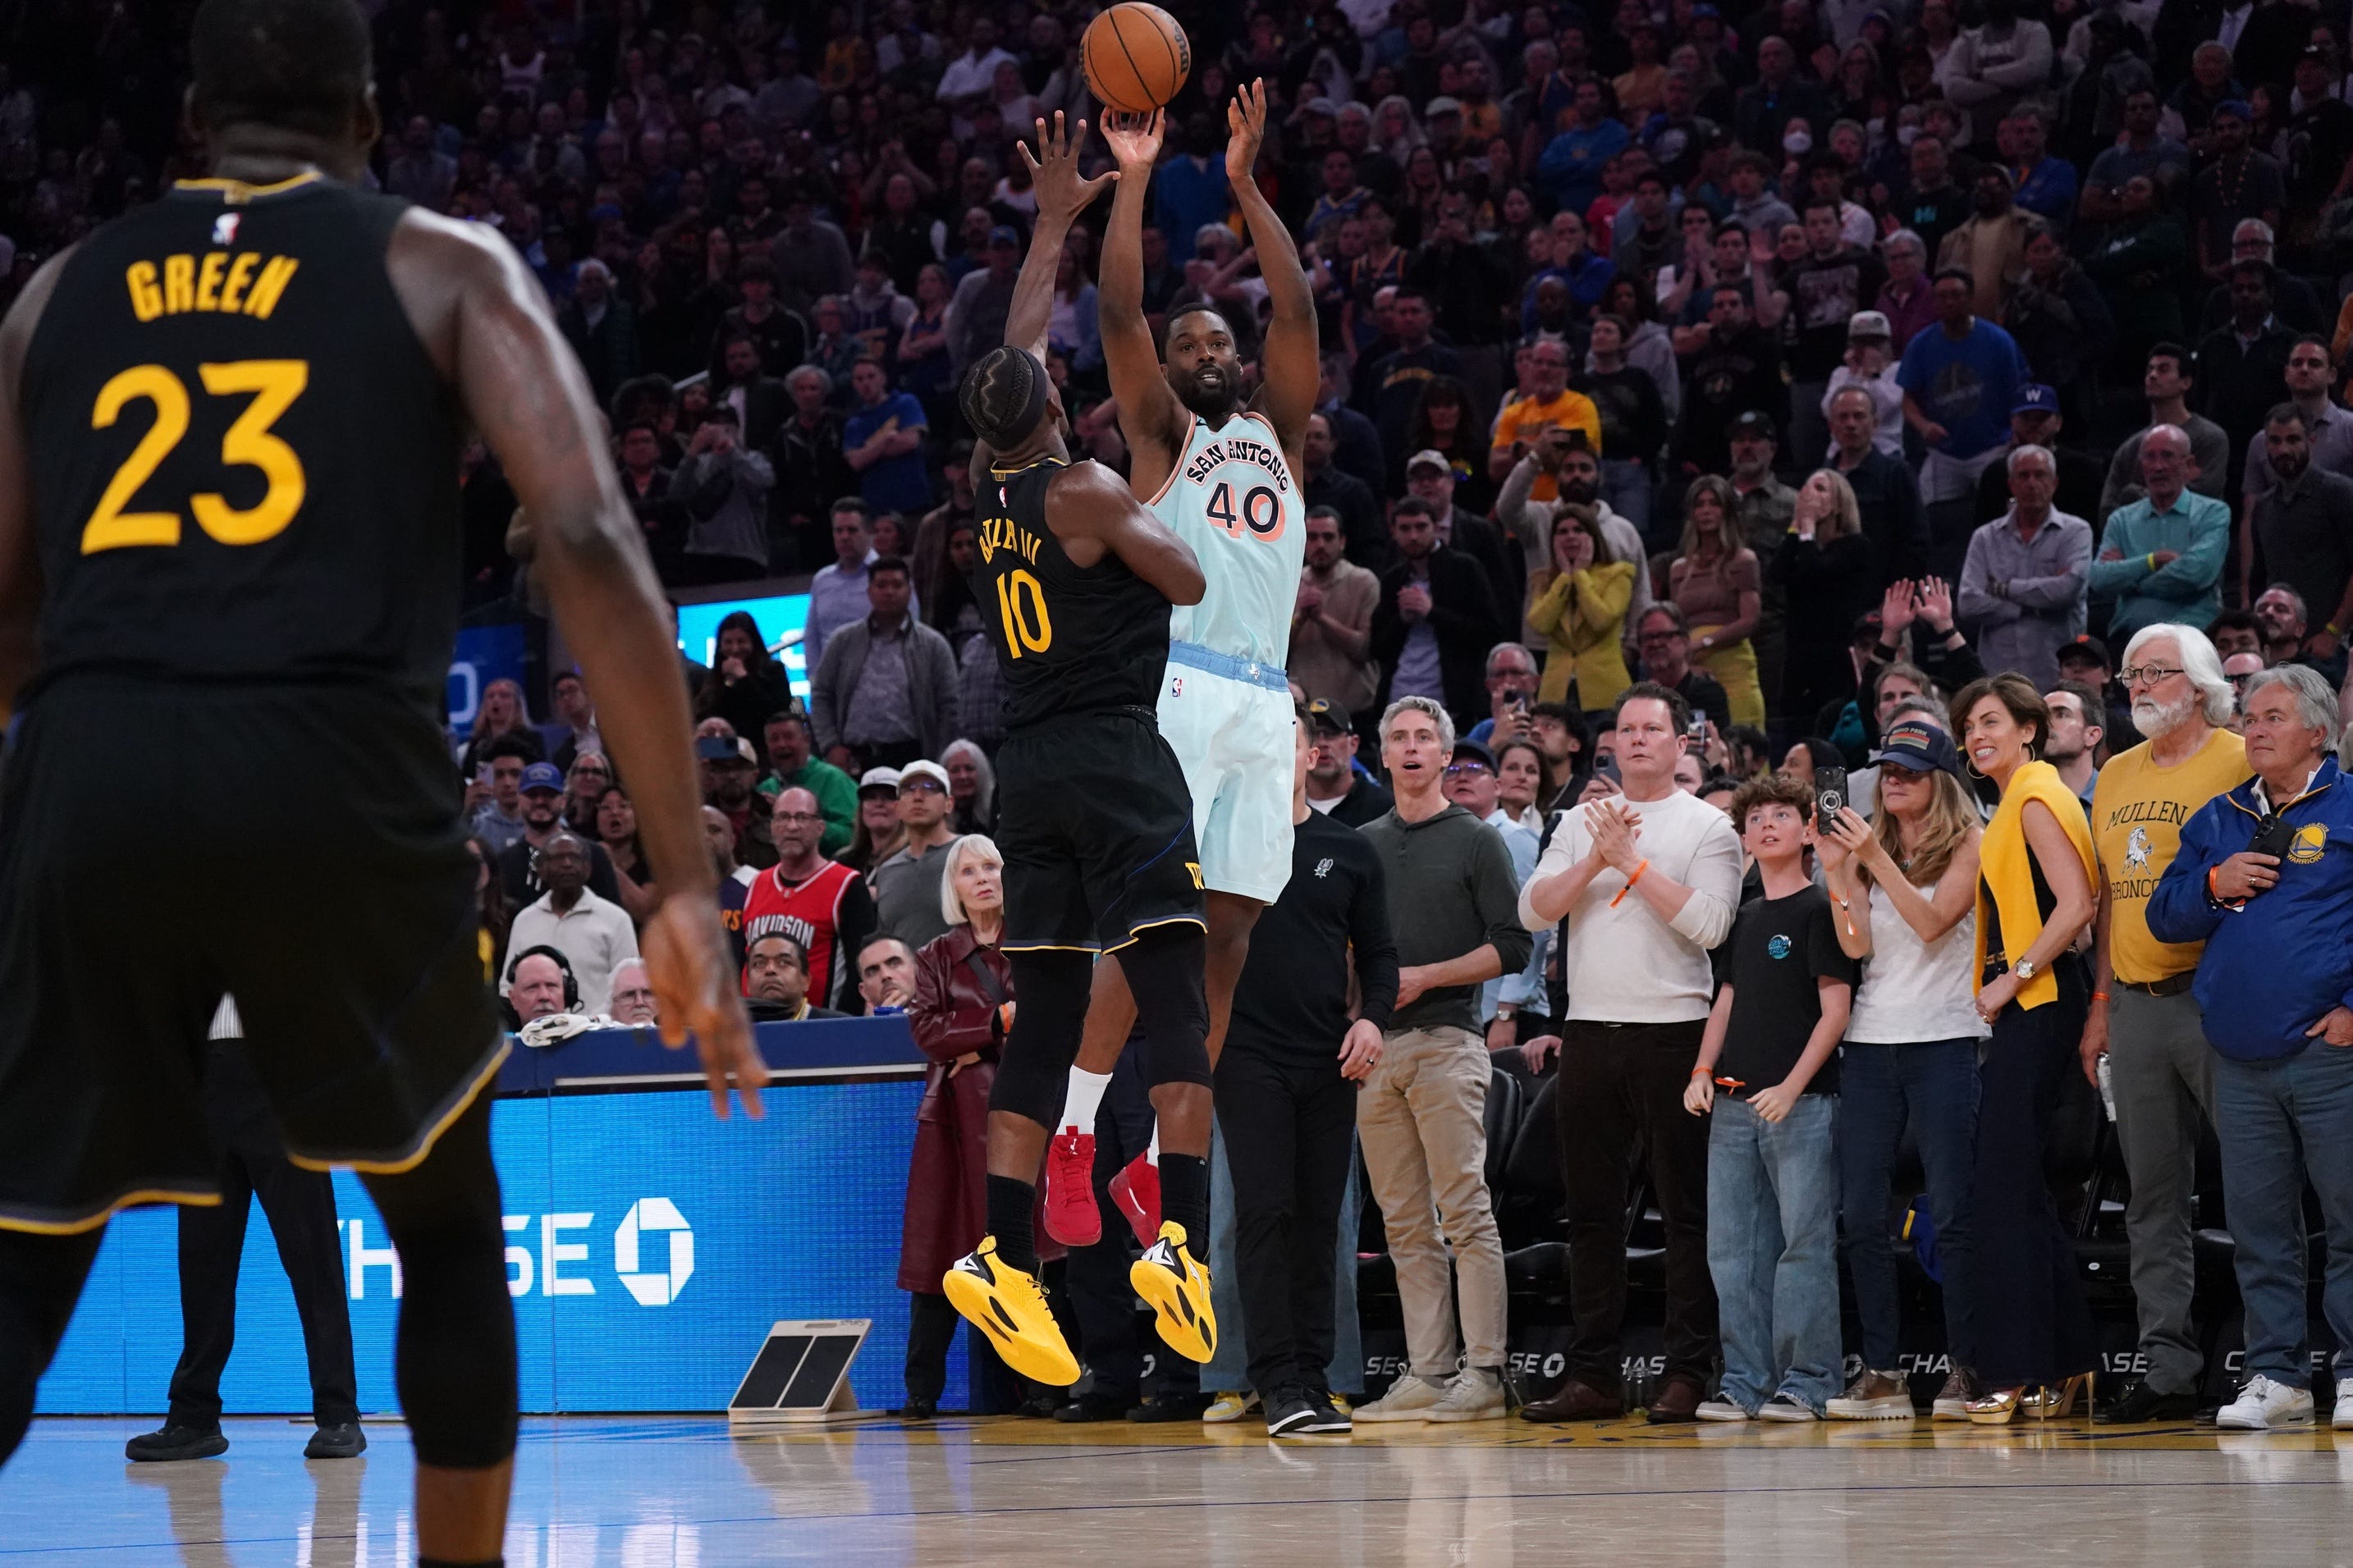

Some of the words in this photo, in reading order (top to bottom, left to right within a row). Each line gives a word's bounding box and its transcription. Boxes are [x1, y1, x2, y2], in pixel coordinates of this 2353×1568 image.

[126, 252, 299, 322] GREEN
[2026, 389, 2042, 402] W
[81, 359, 309, 555] 23
[1185, 442, 1228, 485] SAN
[1226, 438, 1289, 492] ANTONIO
[1206, 481, 1283, 539] 40
[996, 569, 1052, 659] 10
[2105, 801, 2189, 831] MULLEN
[2287, 851, 2325, 864] WARRIORS
[2111, 878, 2162, 901] BRONC
[336, 1212, 597, 1300] HSE
